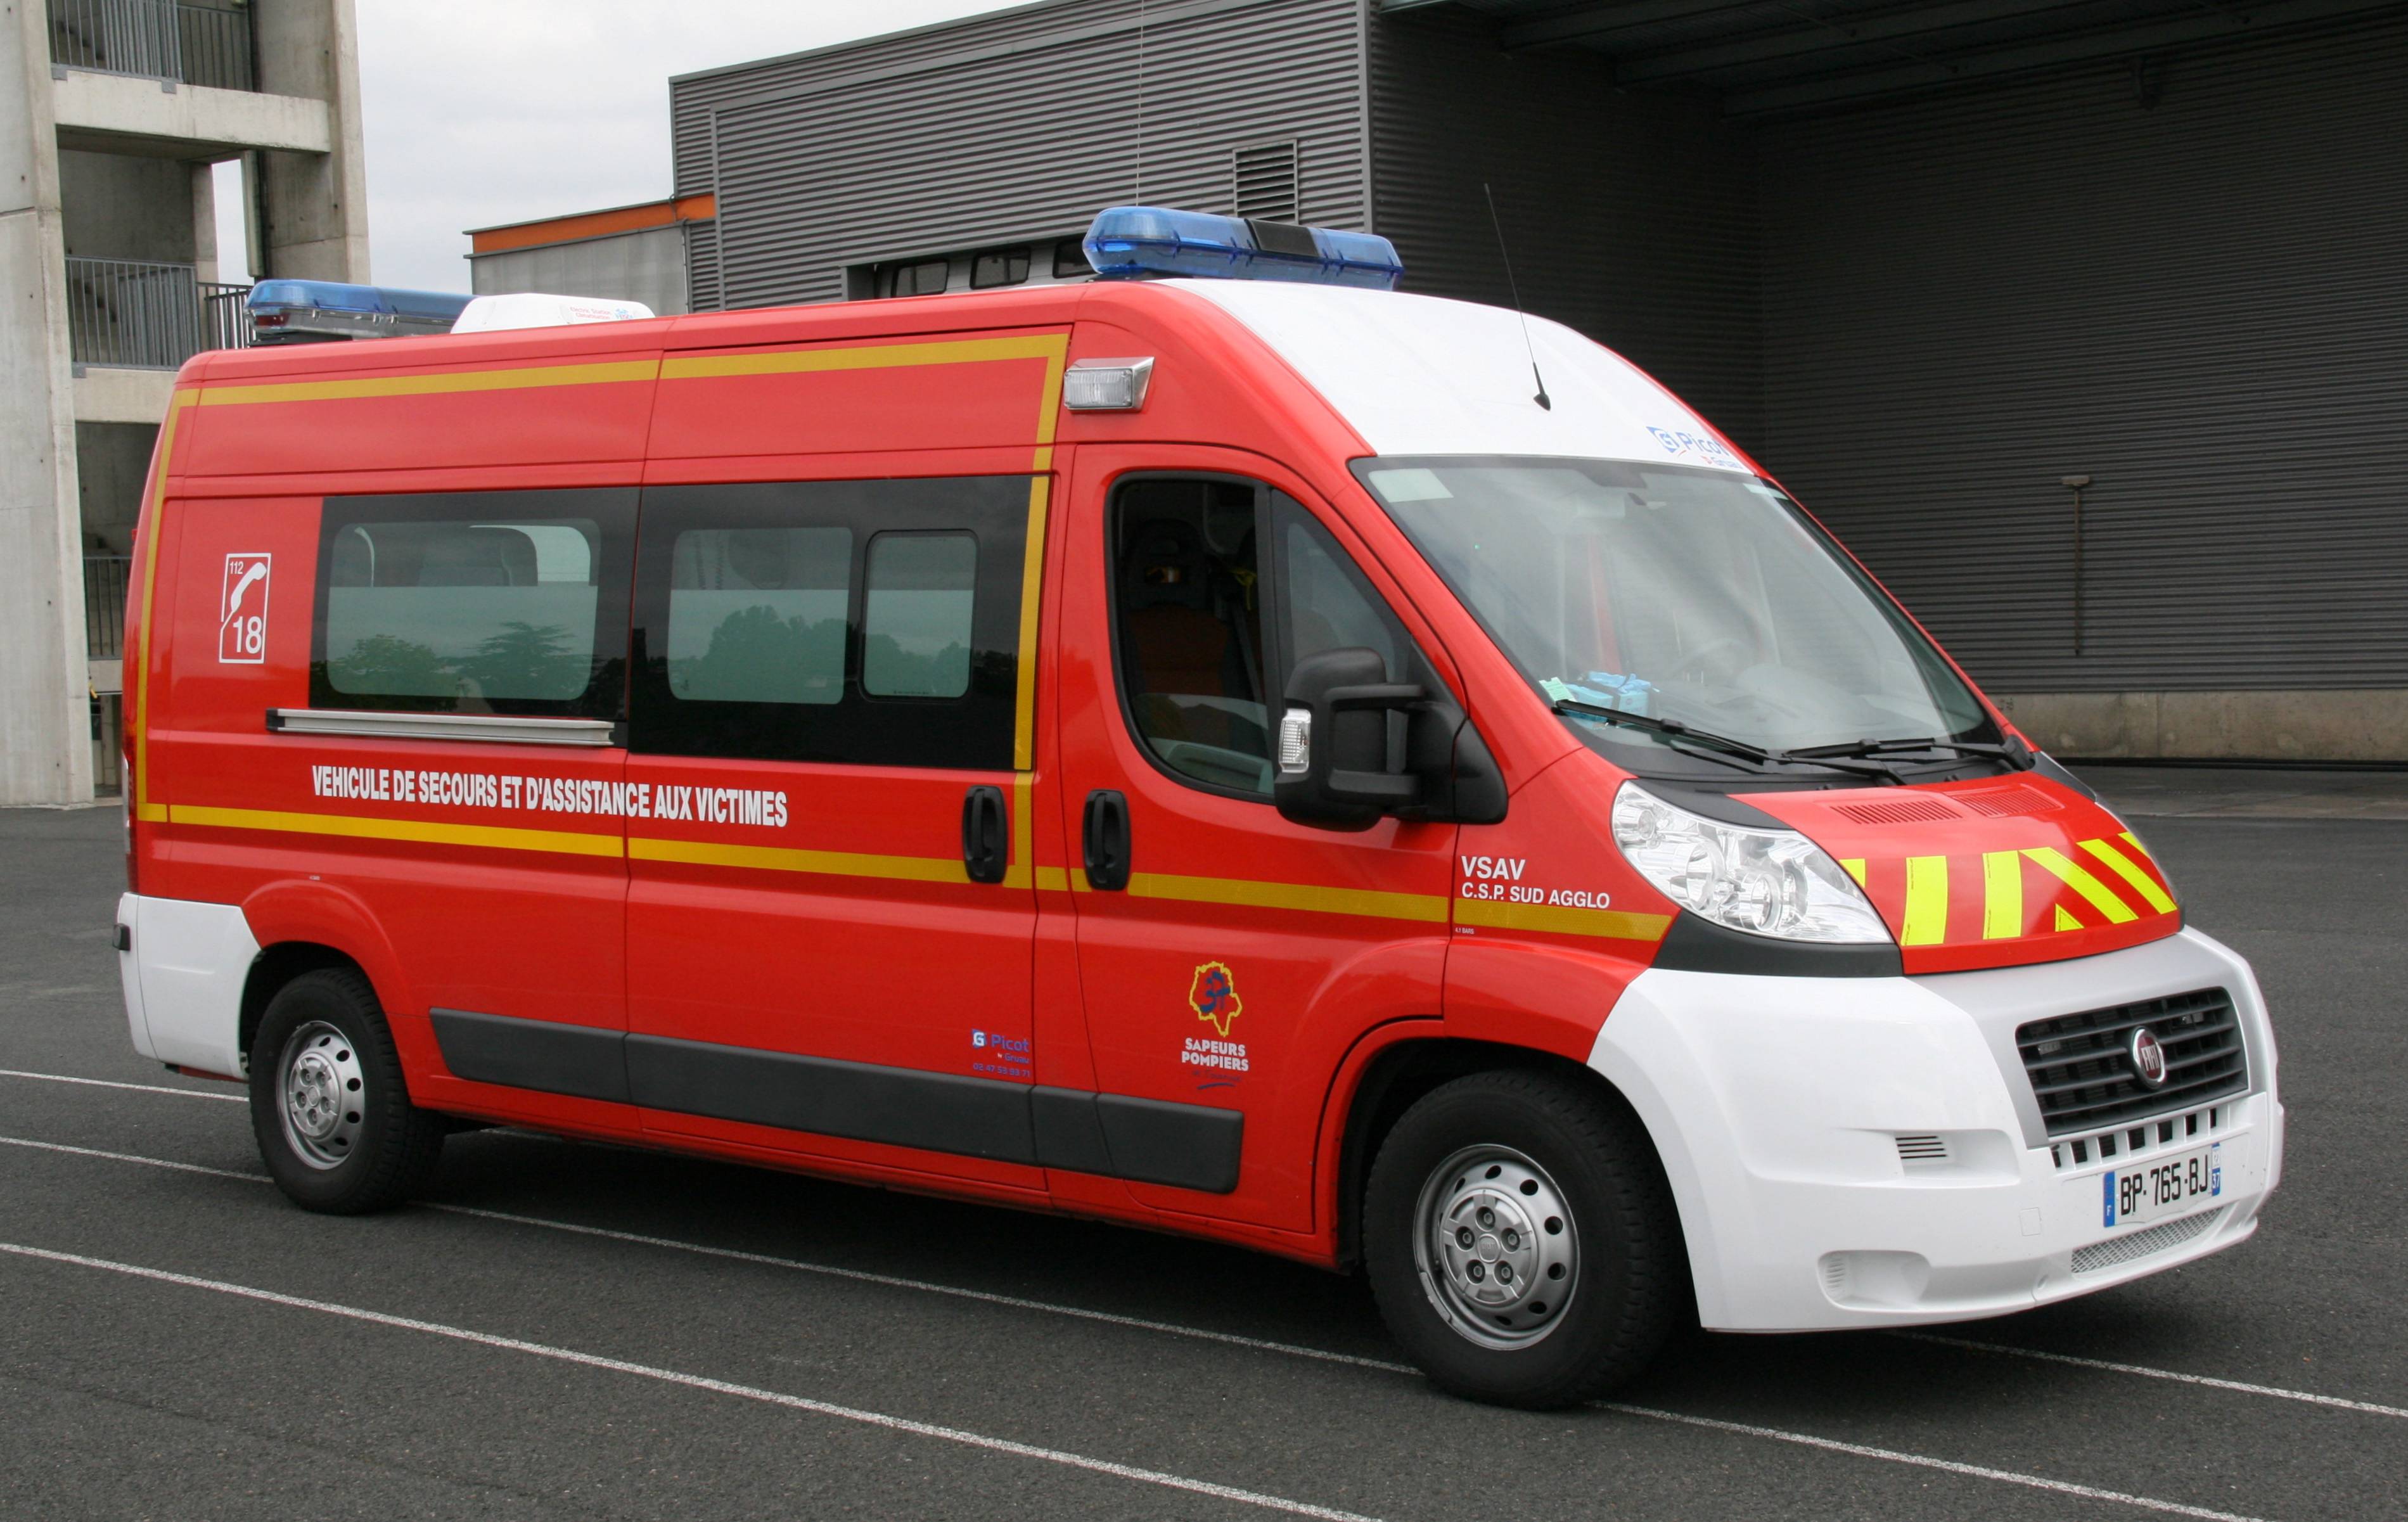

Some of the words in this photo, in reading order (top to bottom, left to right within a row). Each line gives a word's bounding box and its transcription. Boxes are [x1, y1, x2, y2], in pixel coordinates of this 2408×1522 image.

[229, 561, 244, 575] 112
[232, 615, 262, 655] 18
[312, 765, 390, 801] VEHICULE
[392, 769, 416, 802] DE
[418, 771, 497, 809] SECOURS
[501, 775, 523, 809] ET
[526, 776, 651, 819] D'ASSISTANCE
[653, 784, 693, 821] AUX
[695, 786, 788, 828] VICTIMES
[1461, 855, 1526, 881] VSAV
[1461, 881, 1504, 900] C.S.P.
[1509, 885, 1544, 904] SUD
[1547, 890, 1610, 909] AGGLO
[992, 1034, 1029, 1052] Picot
[1185, 1037, 1246, 1057] SAPEURS
[1181, 1051, 1249, 1071] POMPIERS
